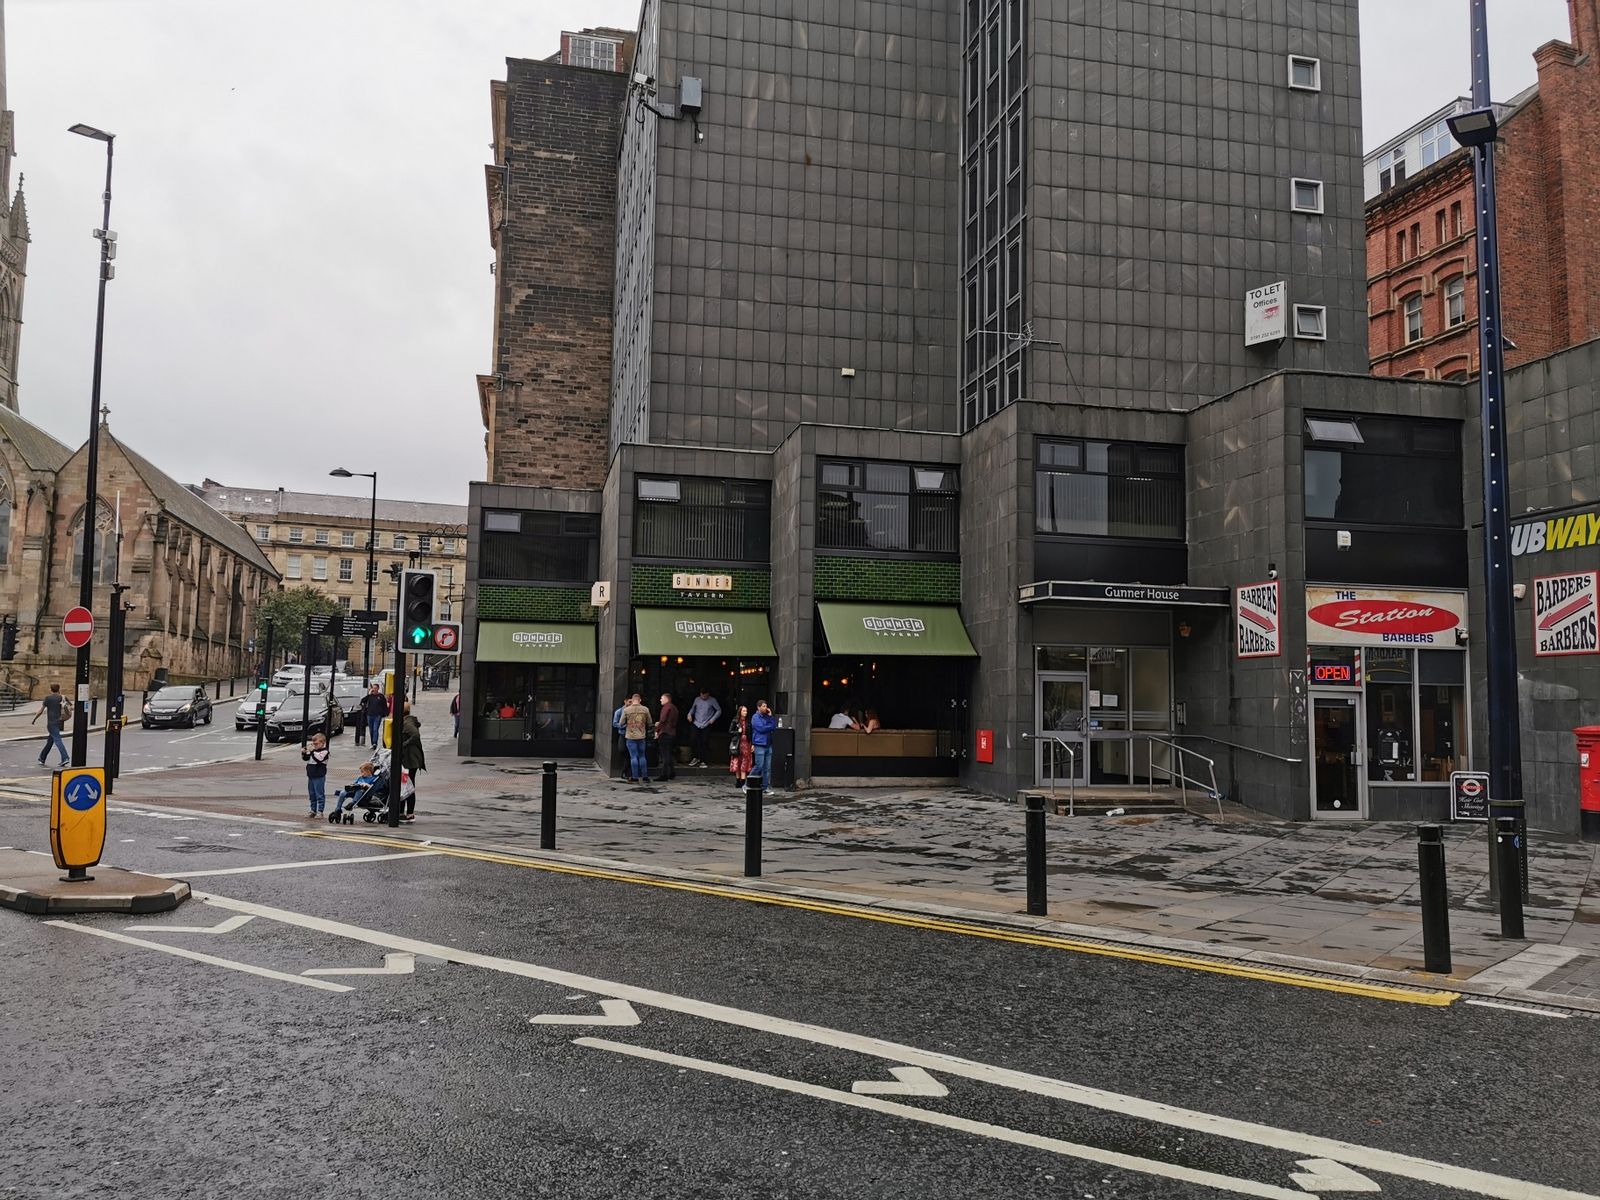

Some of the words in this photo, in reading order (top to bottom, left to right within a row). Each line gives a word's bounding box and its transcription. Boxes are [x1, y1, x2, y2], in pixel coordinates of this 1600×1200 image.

[1250, 290, 1262, 299] TO
[1265, 284, 1281, 296] LET
[1253, 298, 1278, 308] Offices
[1510, 512, 1600, 557] UBWAY
[676, 576, 730, 588] GUNNER
[599, 585, 605, 597] R
[1104, 586, 1145, 598] Gunner
[1147, 589, 1180, 600] House
[1335, 591, 1356, 600] THE
[1536, 575, 1592, 616] BARBERS
[1240, 584, 1277, 616] BARBERS
[1334, 606, 1435, 627] Station
[677, 623, 731, 633] GUNNER
[865, 619, 923, 630] GUNNER
[1540, 610, 1597, 652] BARBERS
[514, 633, 561, 642] GUNNER
[1239, 624, 1276, 654] BARBERS
[1382, 633, 1434, 643] BARBERS
[1316, 666, 1349, 680] OPEN
